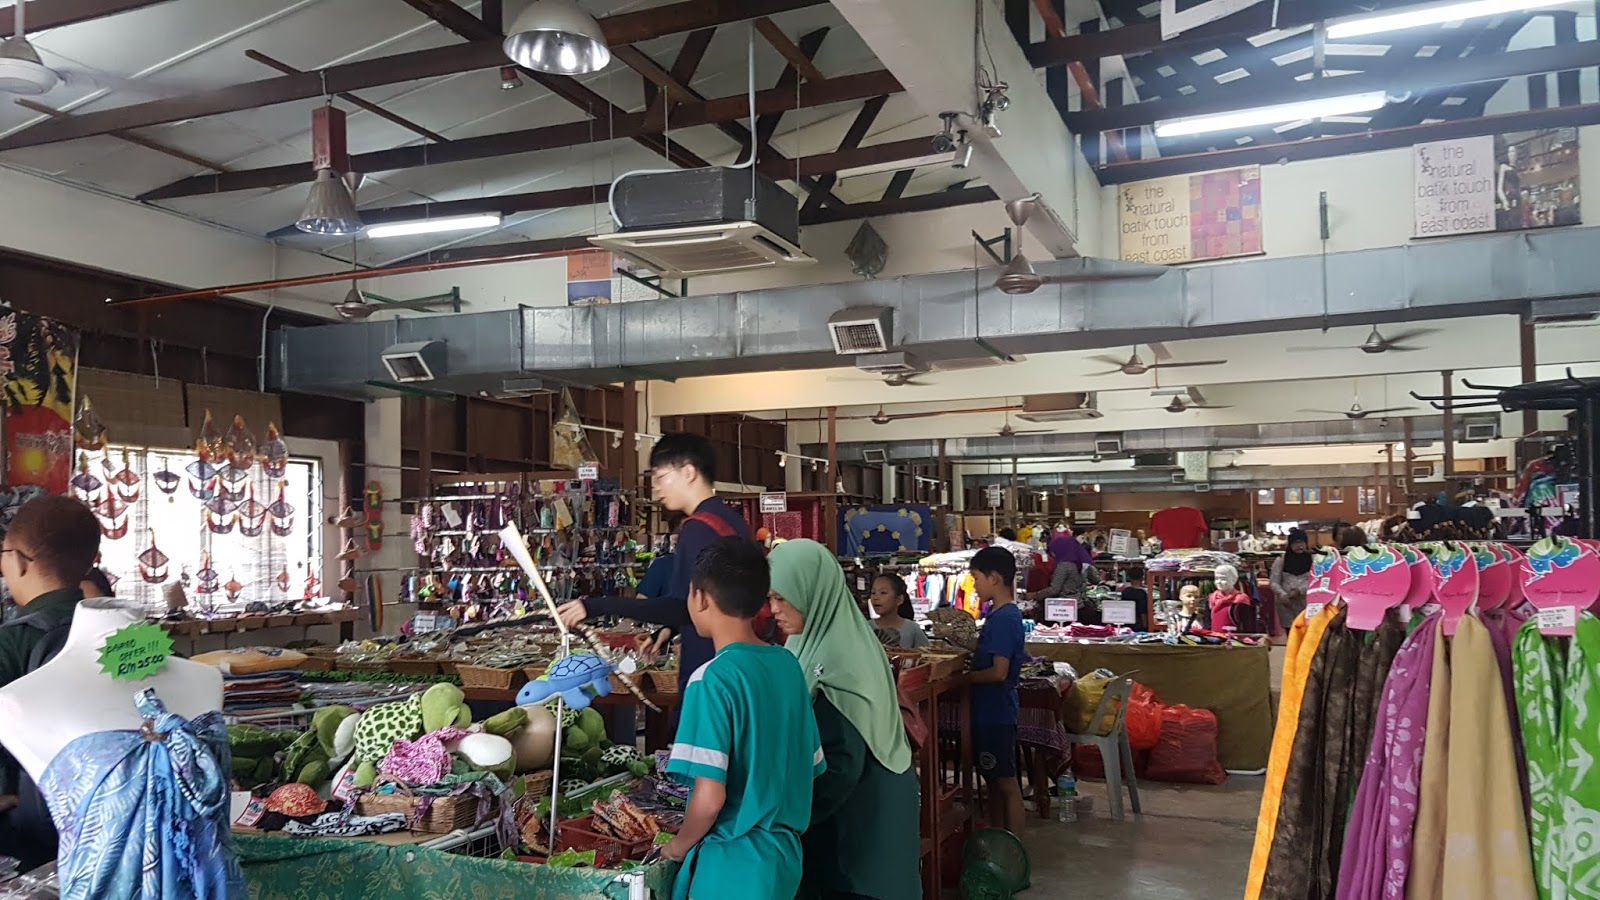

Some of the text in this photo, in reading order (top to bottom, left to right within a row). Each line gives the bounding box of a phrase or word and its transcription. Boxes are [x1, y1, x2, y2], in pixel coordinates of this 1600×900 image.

[1443, 146, 1464, 159] the
[1432, 160, 1475, 178] natural
[1145, 185, 1164, 199] the
[1418, 177, 1490, 197] batik touch
[1134, 199, 1175, 216] natural
[1440, 199, 1469, 213] from
[1122, 214, 1188, 234] batik touch
[1421, 215, 1490, 233] east coast
[1142, 233, 1169, 247] from
[1154, 247, 1187, 262] coast
